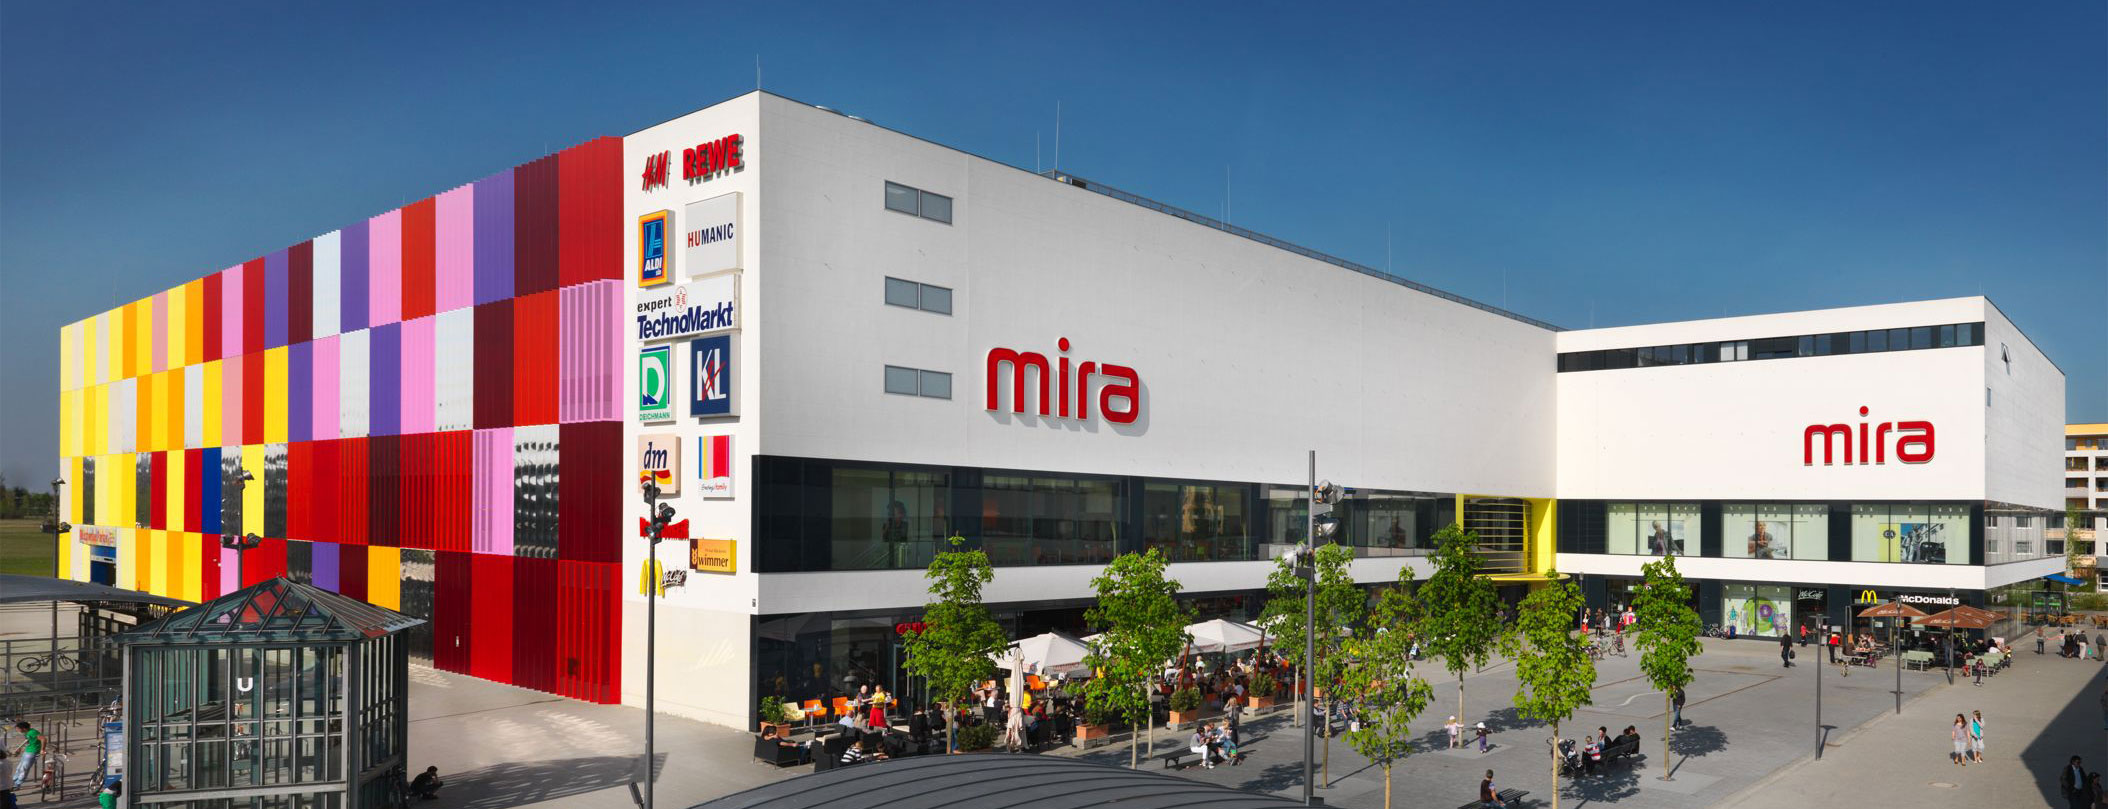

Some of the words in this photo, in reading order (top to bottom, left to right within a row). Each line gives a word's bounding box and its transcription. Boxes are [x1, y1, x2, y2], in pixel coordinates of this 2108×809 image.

[683, 133, 740, 181] REWE
[688, 223, 734, 248] HUMANIC
[645, 257, 662, 271] ALDI
[637, 296, 672, 313] expert
[637, 301, 734, 340] TechnoMarkt
[985, 336, 1140, 424] mira
[640, 412, 671, 421] DEICHMANN
[1803, 405, 1936, 466] mira
[643, 441, 668, 470] dm
[698, 554, 729, 567] wimmer
[1900, 594, 1960, 605] McDonalds
[237, 677, 254, 692] U
